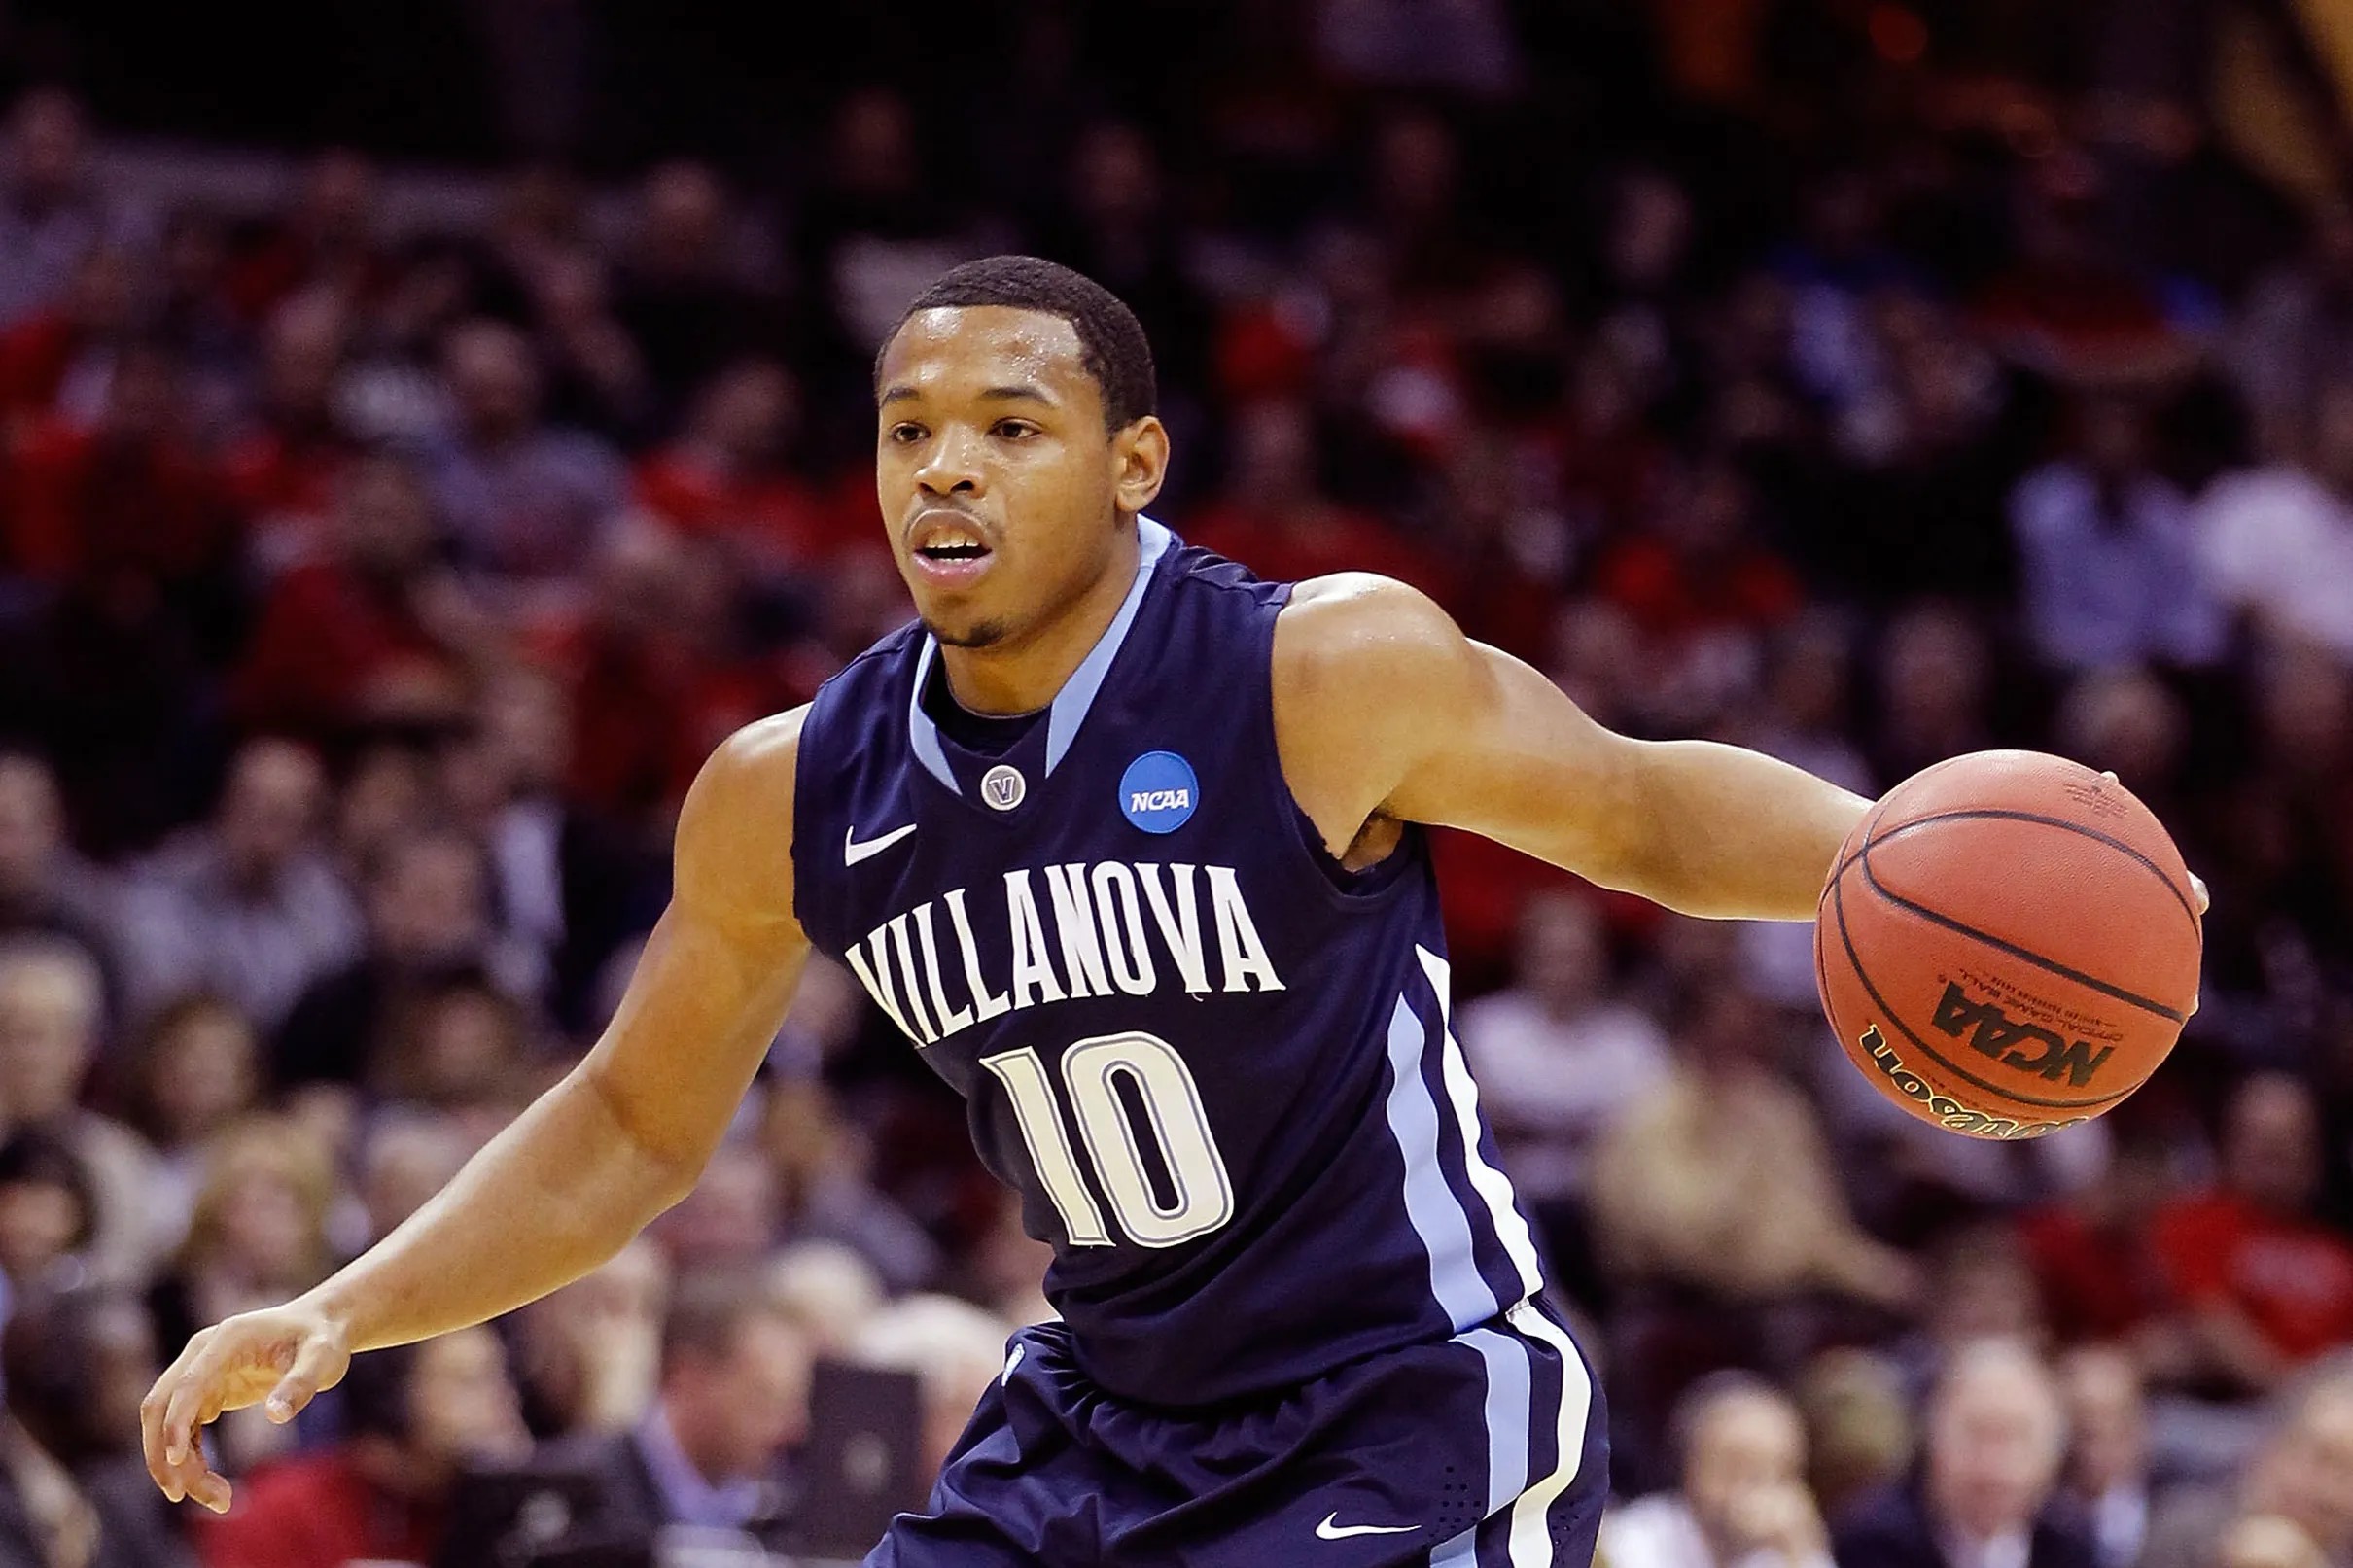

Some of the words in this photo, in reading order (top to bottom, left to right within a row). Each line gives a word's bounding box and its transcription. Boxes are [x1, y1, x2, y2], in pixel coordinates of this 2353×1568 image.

[989, 777, 1015, 804] V
[1131, 789, 1190, 813] NCAA
[845, 860, 1285, 1050] VILLANOVA
[1933, 981, 2116, 1087] NCAA
[979, 1031, 1234, 1248] 10
